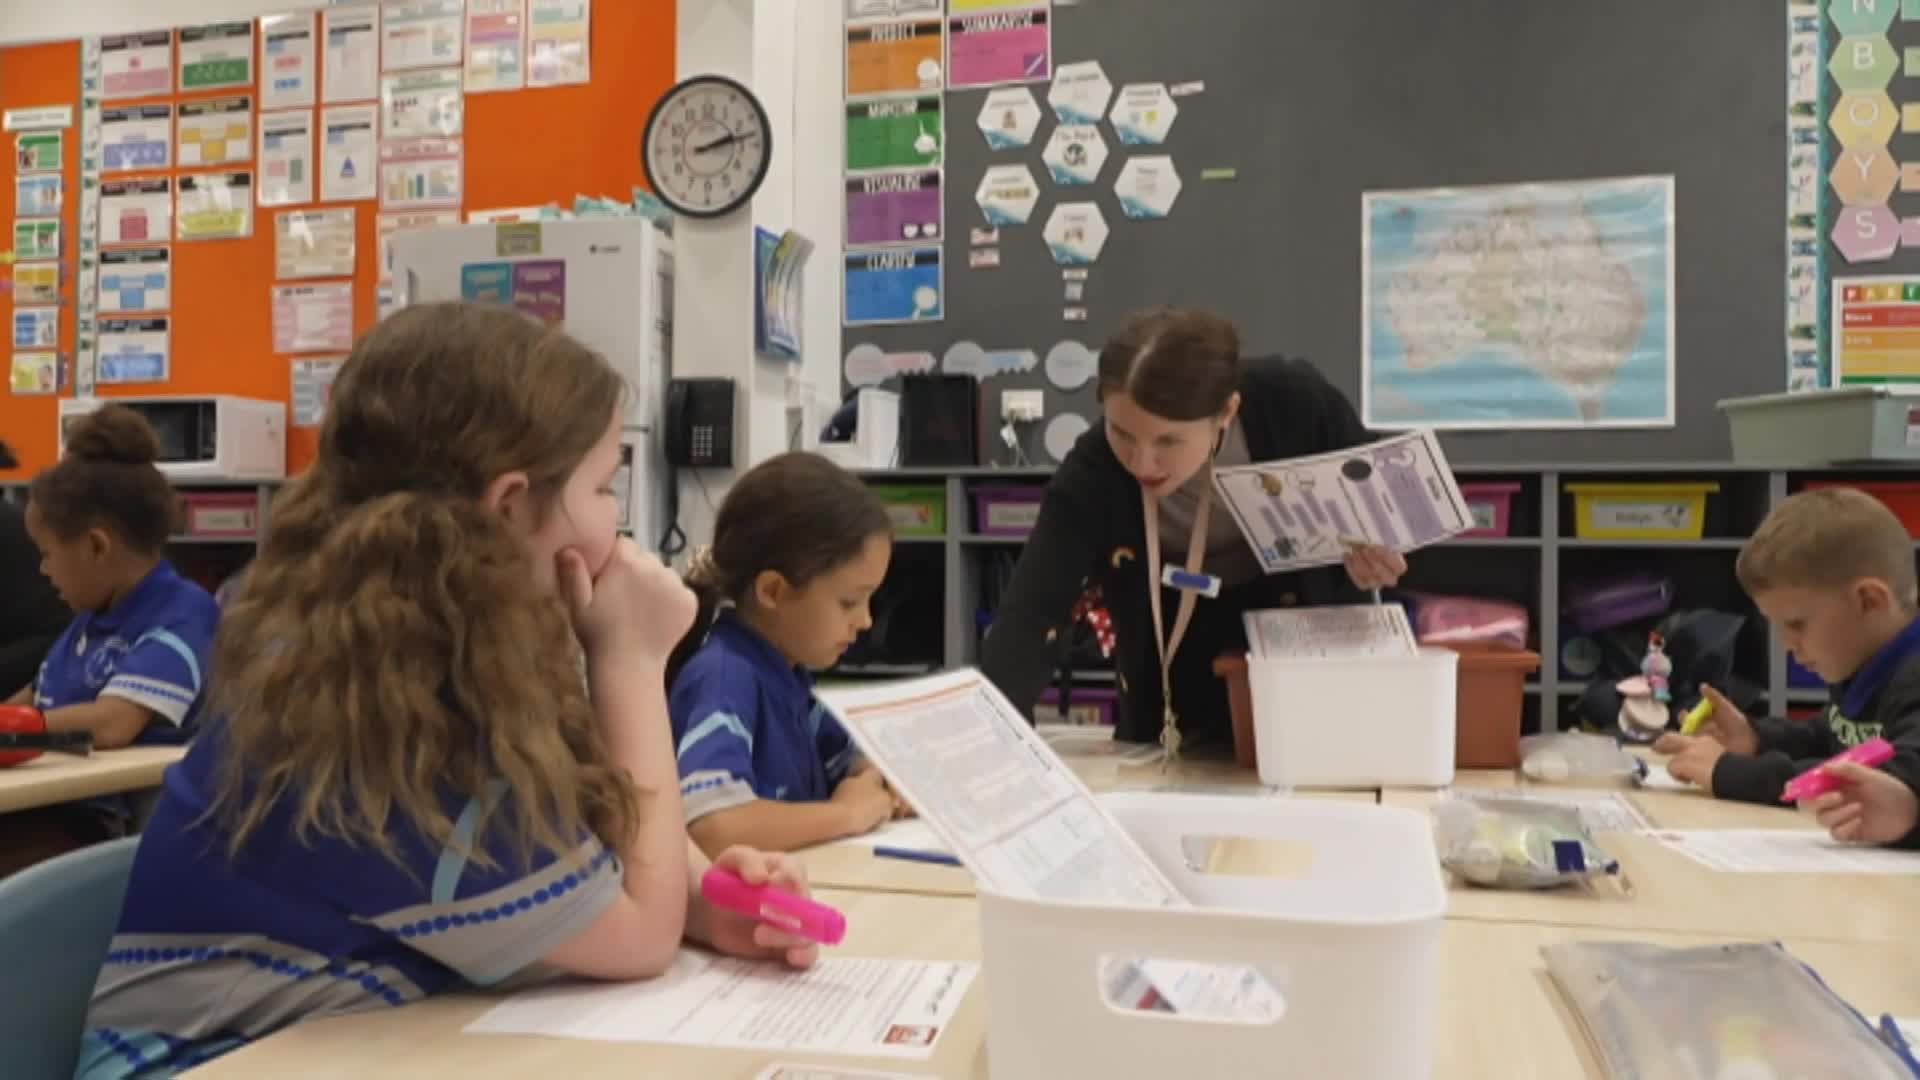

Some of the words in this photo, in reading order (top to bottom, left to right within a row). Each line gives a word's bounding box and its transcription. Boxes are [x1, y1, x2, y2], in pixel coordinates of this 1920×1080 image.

[1853, 41, 1875, 71] B
[1849, 96, 1879, 127] O
[1854, 152, 1876, 181] Y
[1855, 210, 1878, 240] S
